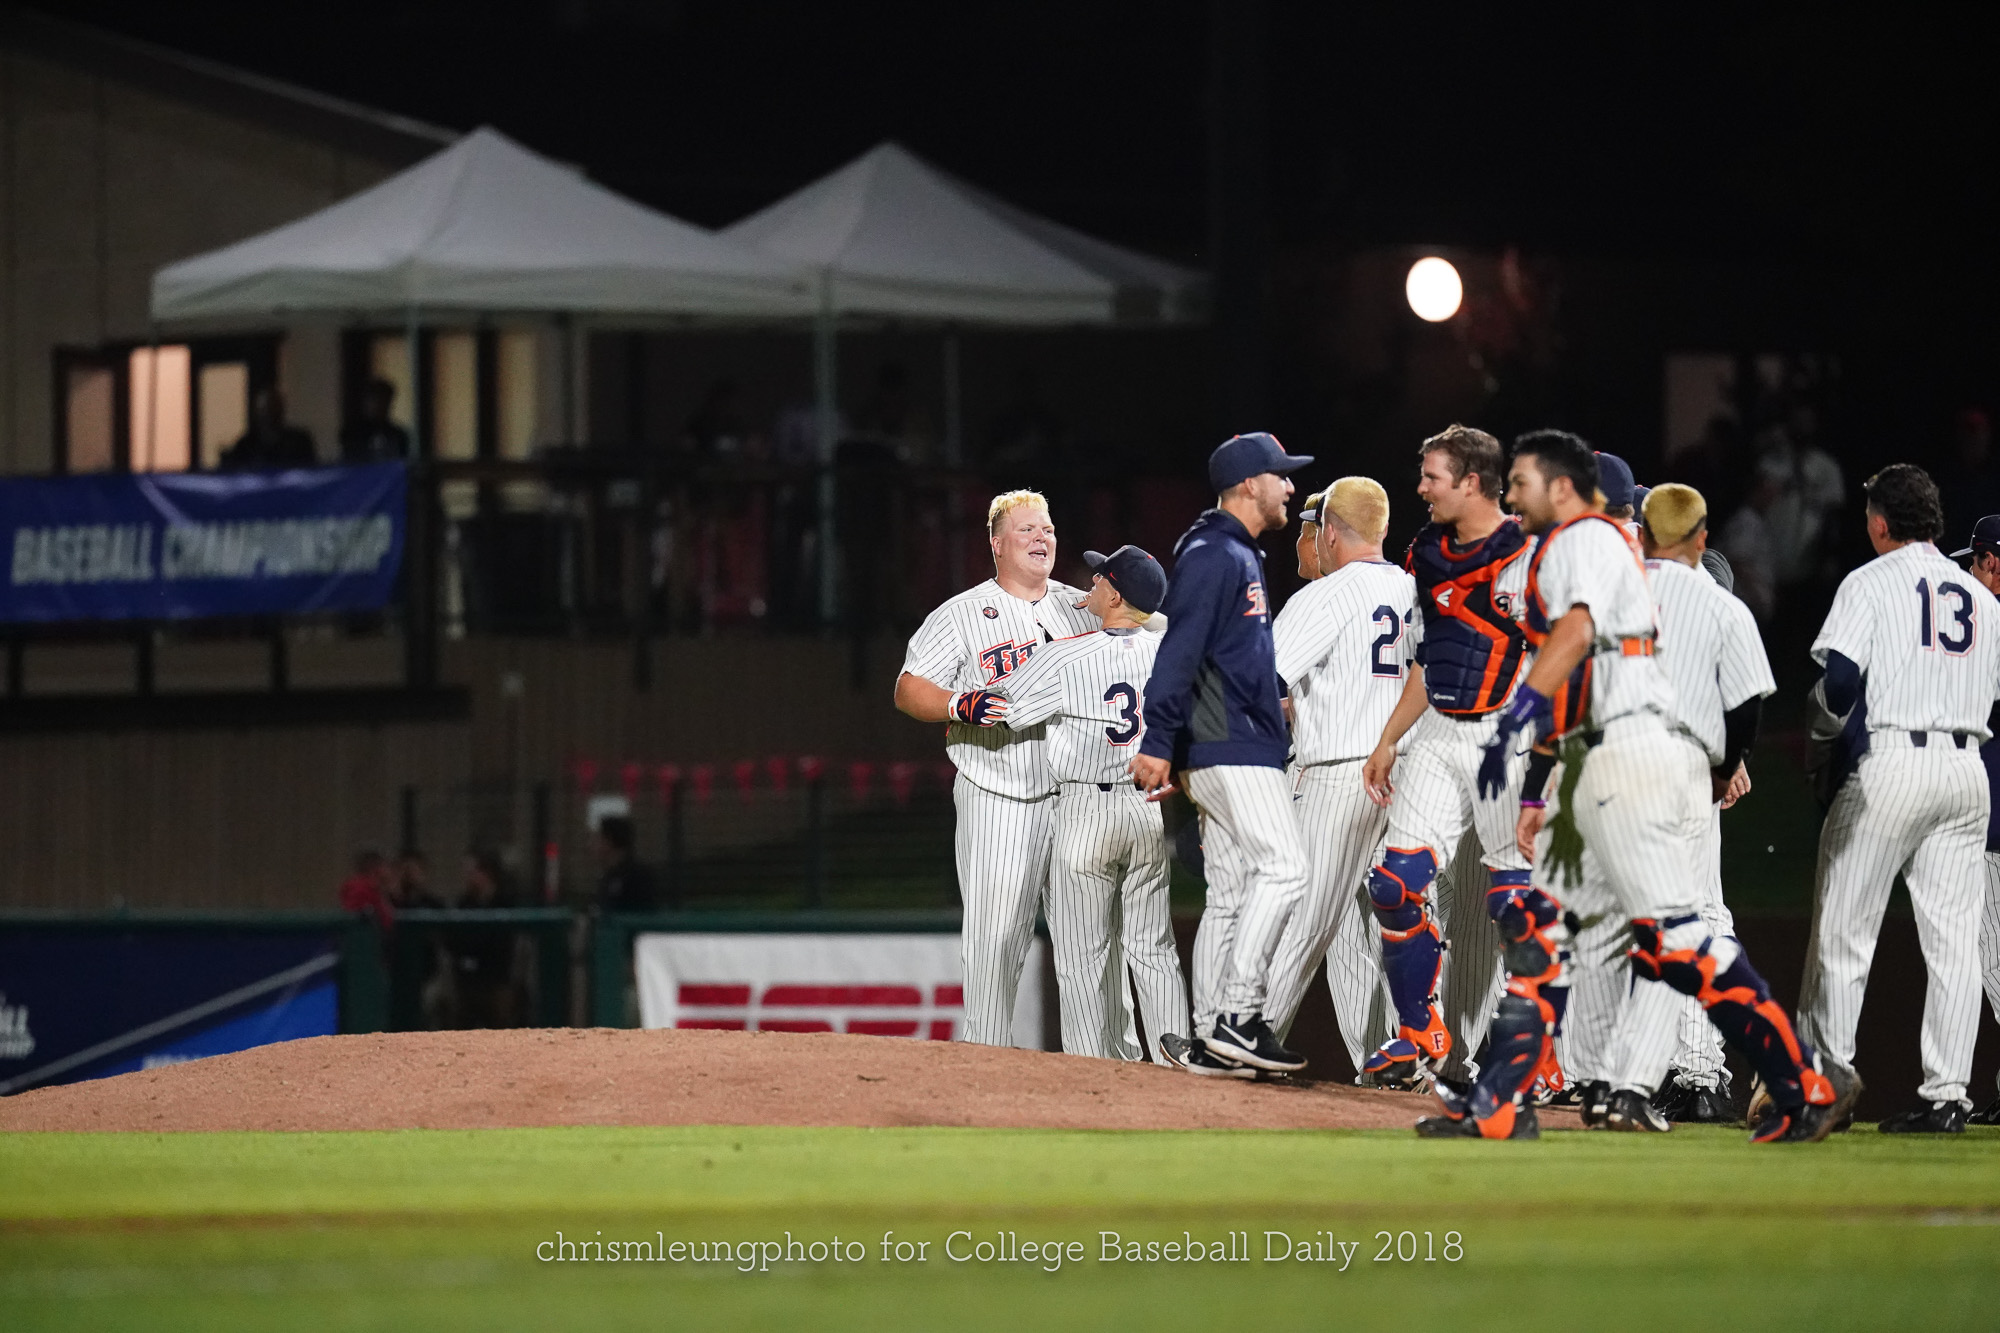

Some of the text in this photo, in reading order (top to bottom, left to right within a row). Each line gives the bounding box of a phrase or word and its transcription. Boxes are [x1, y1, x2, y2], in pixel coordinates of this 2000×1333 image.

[11, 522, 154, 584] BASEBALL
[1371, 604, 1413, 679] 2
[1916, 577, 1977, 657] 13
[1104, 682, 1142, 747] 3
[1431, 1031, 1445, 1053] F
